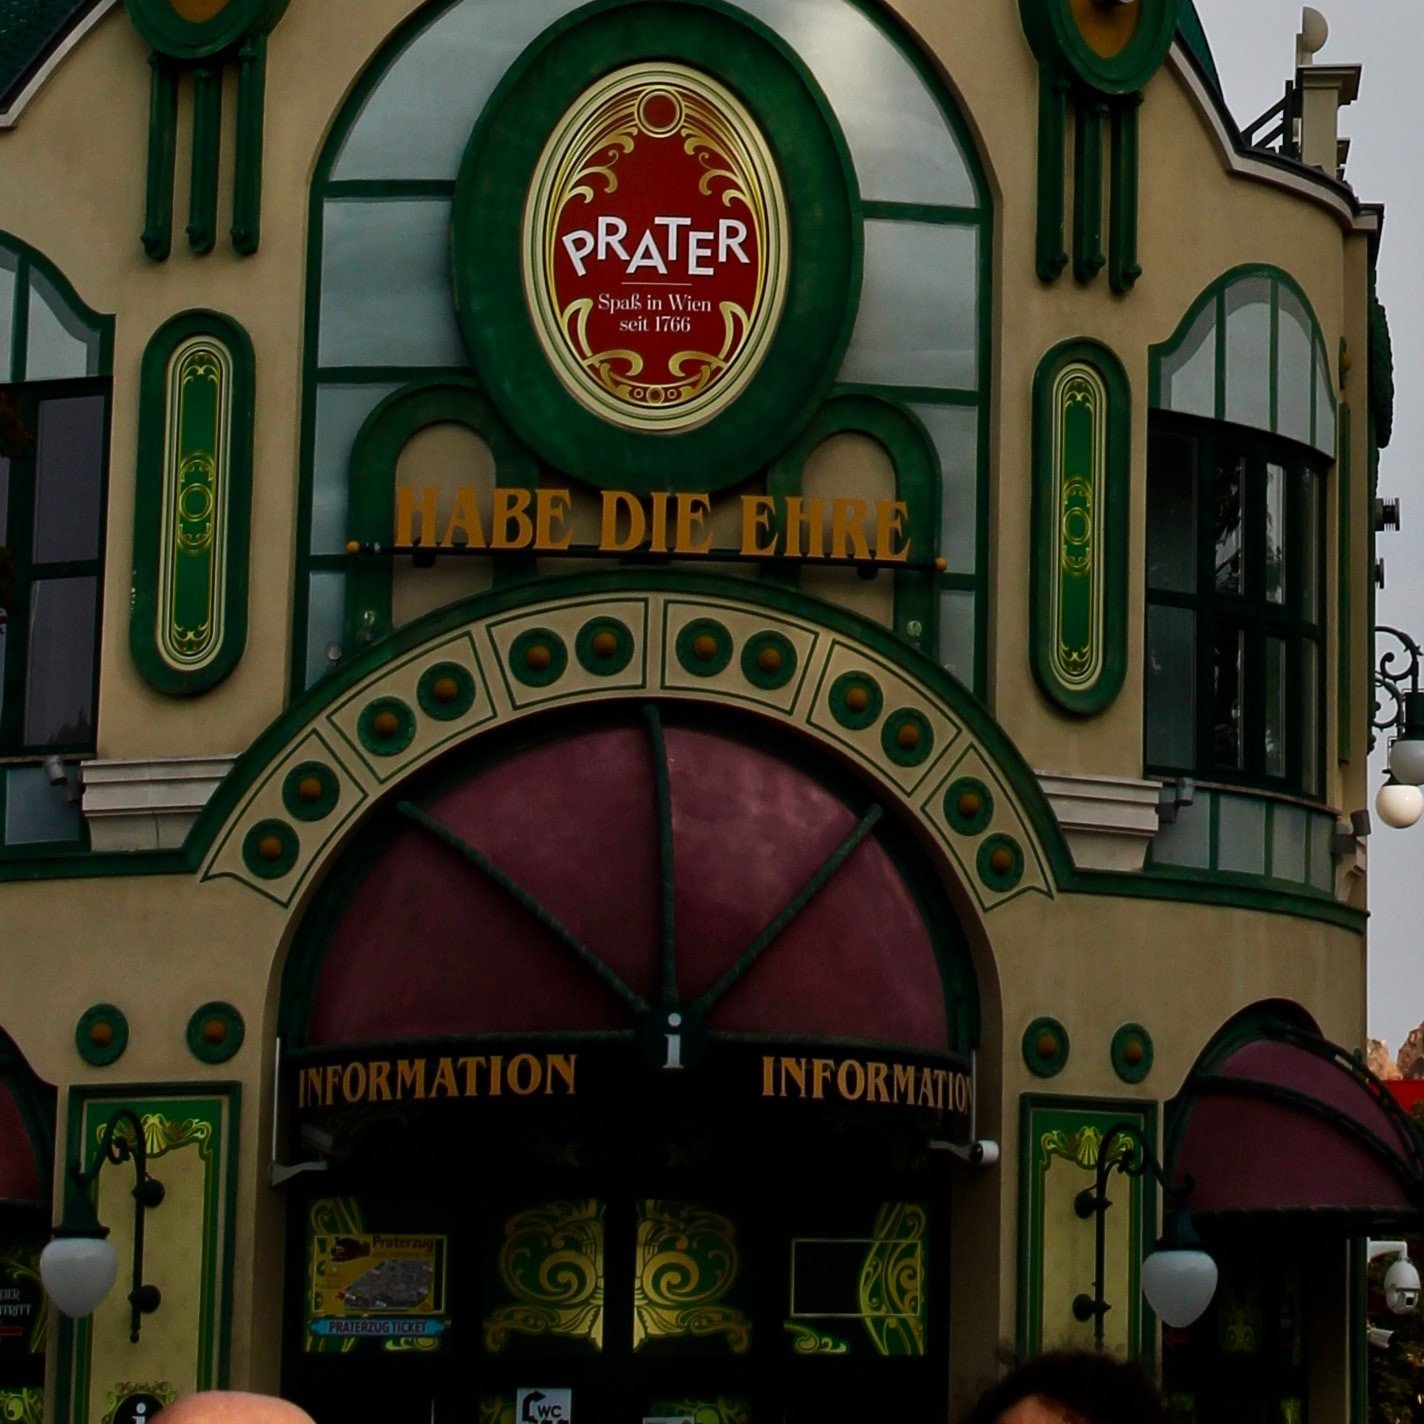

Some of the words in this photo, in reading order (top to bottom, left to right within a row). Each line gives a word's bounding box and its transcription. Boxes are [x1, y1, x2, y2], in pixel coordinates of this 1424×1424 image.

[562, 216, 751, 277] PRATER
[598, 292, 642, 315] Spaß
[647, 294, 662, 311] in
[668, 294, 712, 312] Wien
[619, 315, 649, 332] seit
[654, 316, 691, 333] 1766
[394, 487, 574, 551] HABE
[598, 489, 715, 555] DIE
[739, 495, 913, 563] EHRE
[298, 1053, 578, 1109] INFORMATION
[372, 1235, 434, 1251] Praterzug
[328, 1321, 389, 1333] PRATERZUG
[392, 1321, 427, 1333] TICKET
[537, 1405, 562, 1418] WC
